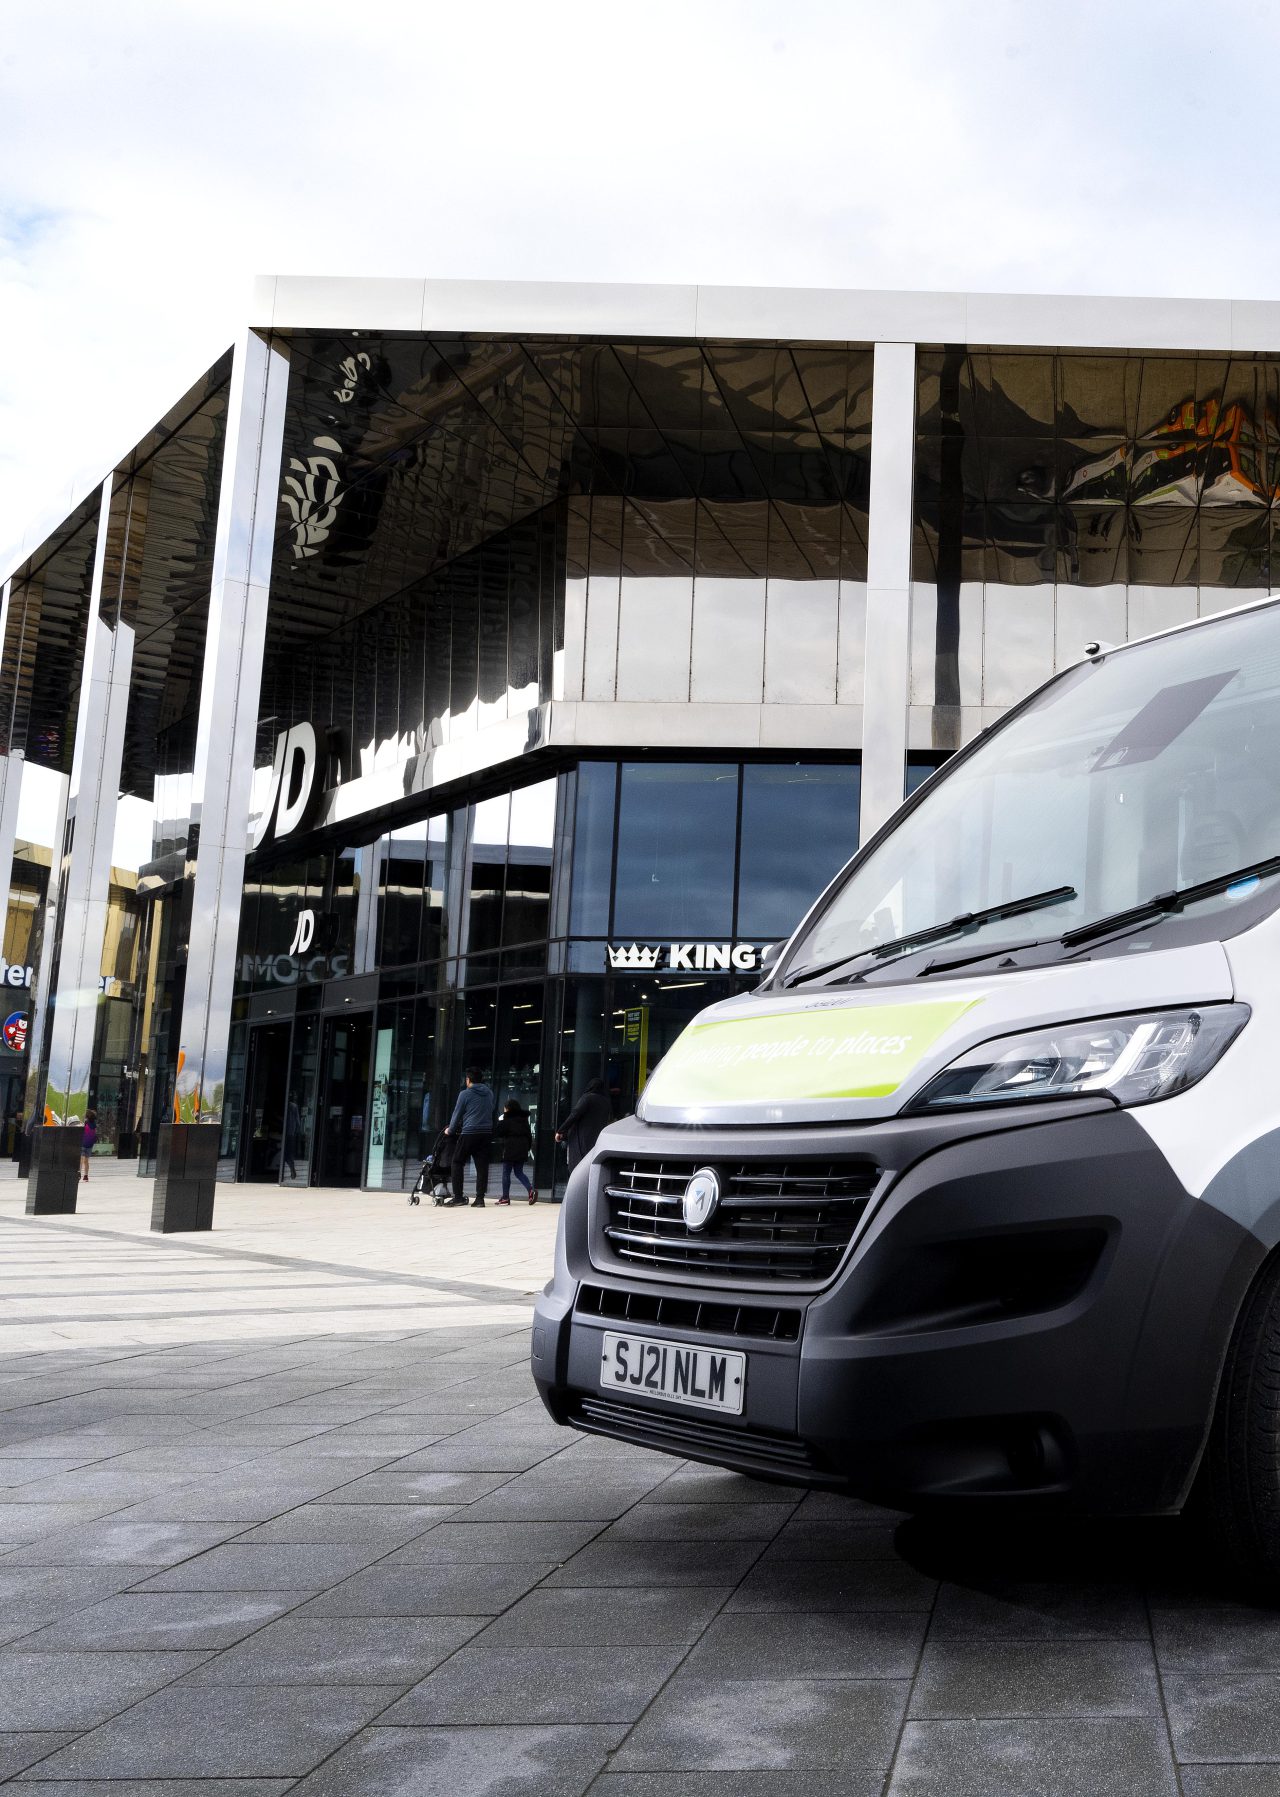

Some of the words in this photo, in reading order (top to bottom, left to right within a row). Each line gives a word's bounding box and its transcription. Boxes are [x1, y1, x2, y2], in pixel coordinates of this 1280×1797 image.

[250, 721, 317, 850] JD
[289, 909, 315, 957] JD
[828, 1029, 914, 1062] places
[614, 1340, 668, 1391] SJ21
[673, 1349, 727, 1402] NLM
